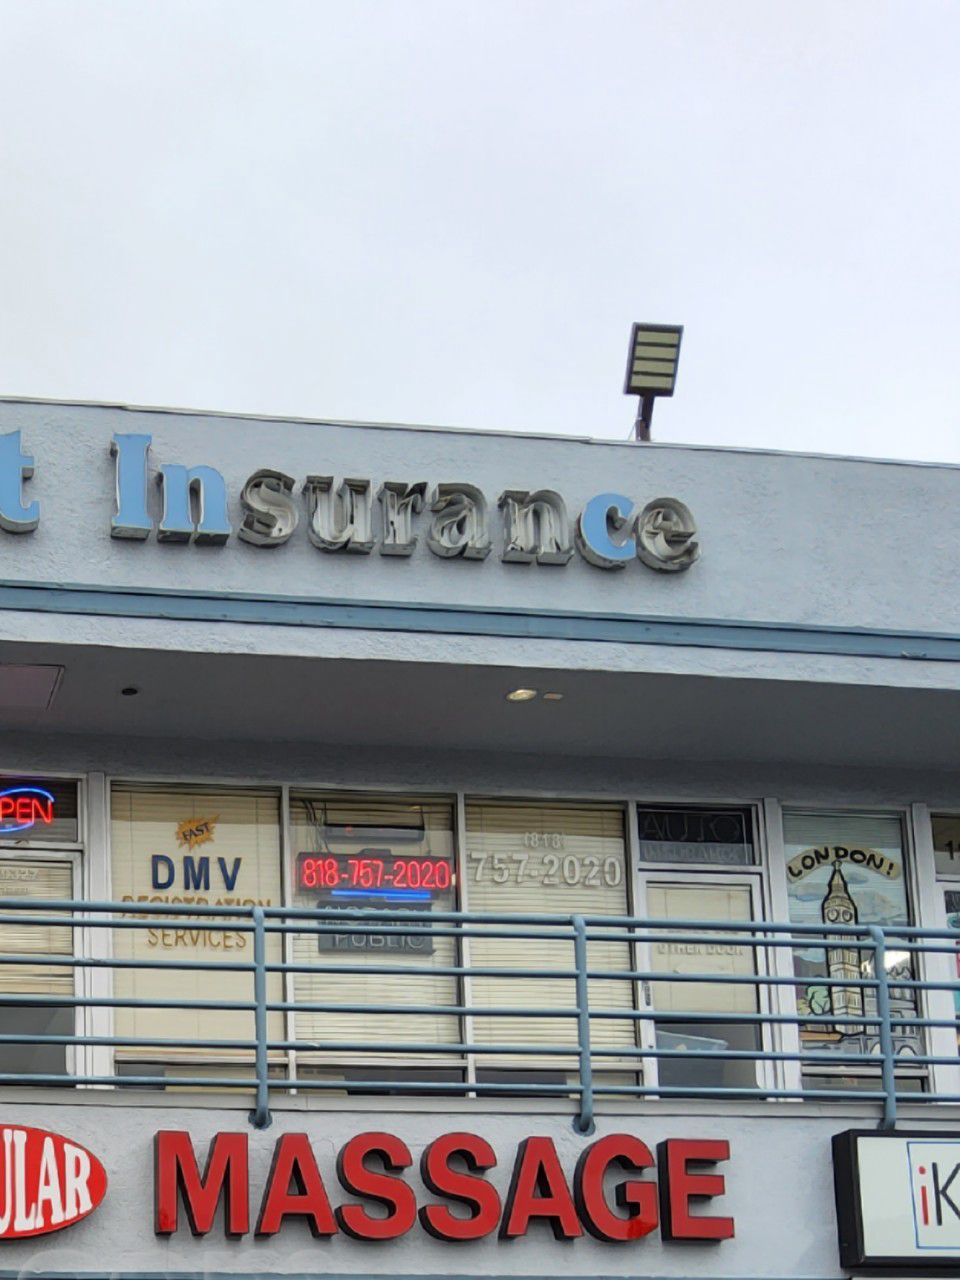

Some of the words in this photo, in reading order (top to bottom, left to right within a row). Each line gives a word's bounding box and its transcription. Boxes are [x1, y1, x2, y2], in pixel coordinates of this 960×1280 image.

[109, 433, 702, 573] Insurance
[181, 821, 212, 840] FAST
[151, 854, 243, 892] DMV
[302, 857, 451, 890] 818-757-2020
[470, 851, 622, 887] 757-2020
[788, 845, 895, 878] LONDON!
[147, 927, 248, 949] SERVICES
[333, 933, 426, 950] PUBLIC
[153, 1130, 736, 1242] MASSAGE
